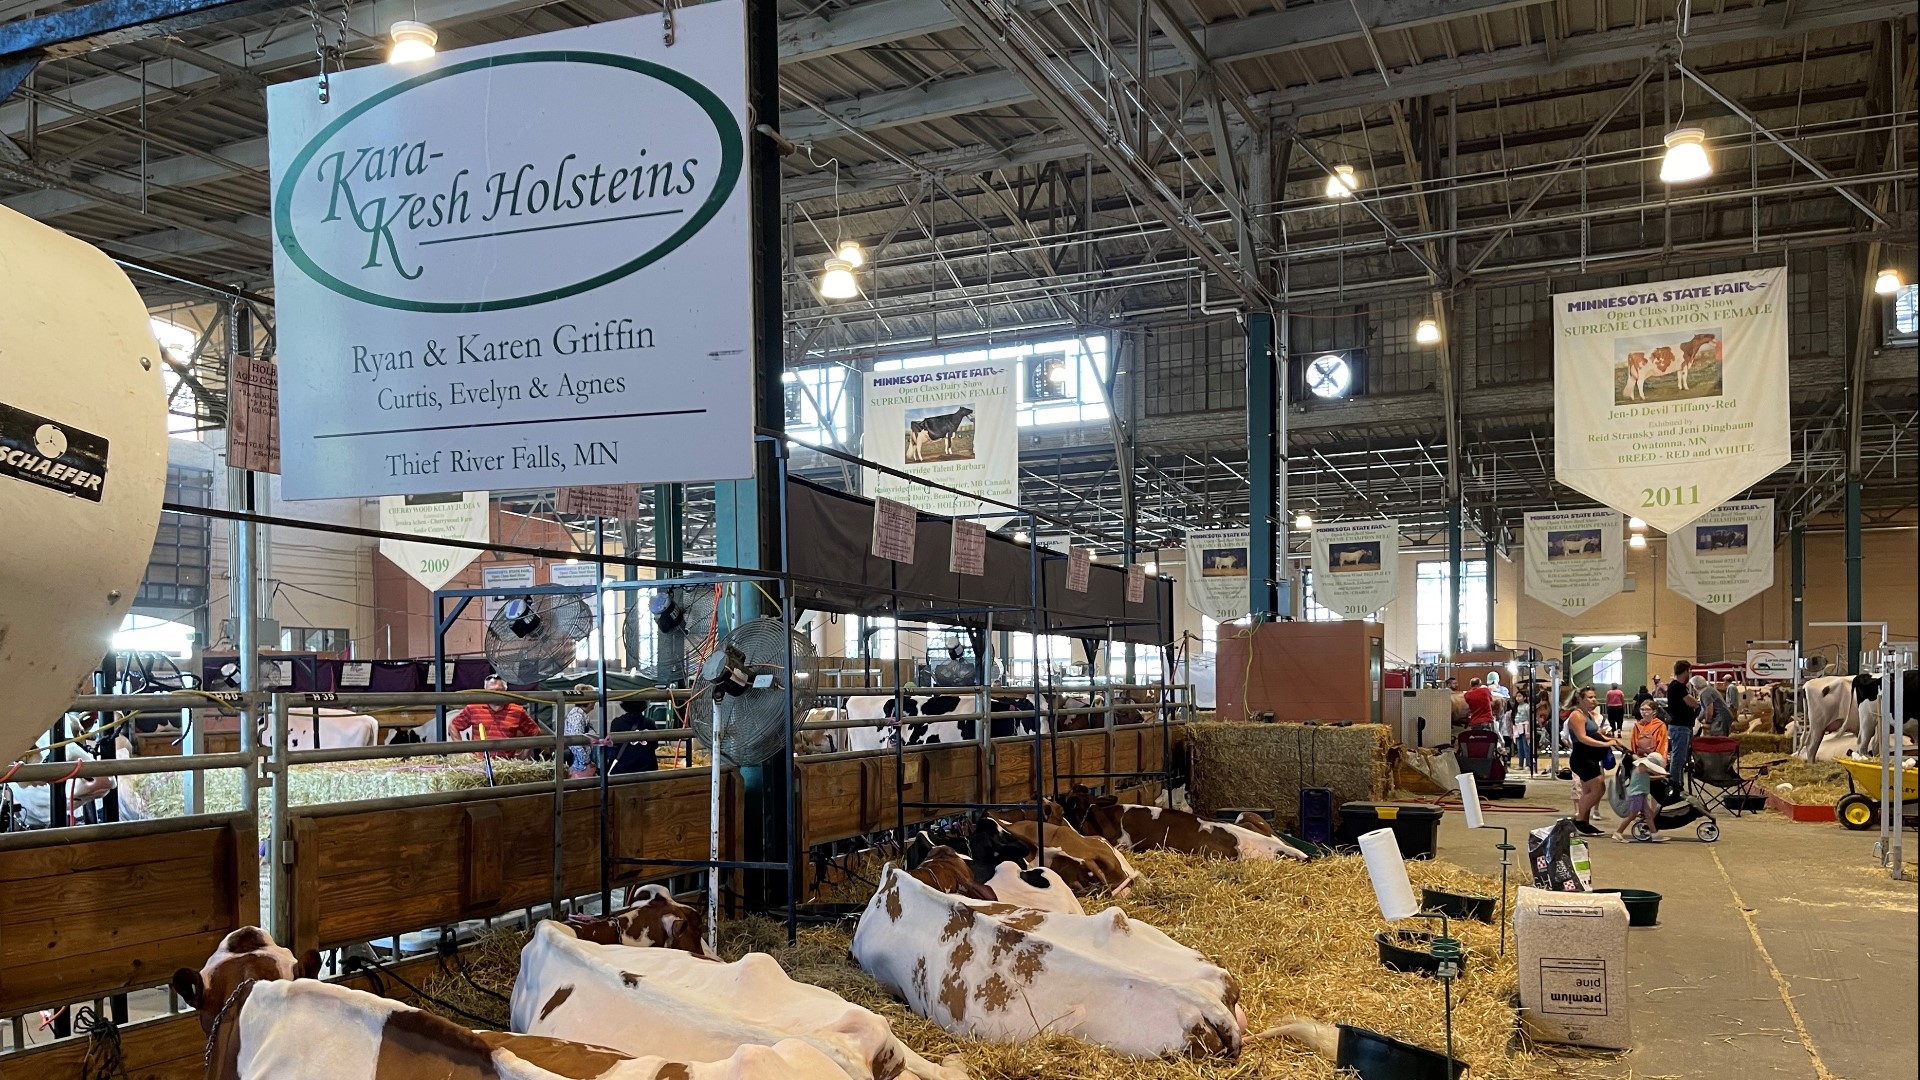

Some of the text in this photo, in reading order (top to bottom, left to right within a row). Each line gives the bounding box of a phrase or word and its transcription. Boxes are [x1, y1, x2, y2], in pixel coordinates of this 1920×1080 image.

[317, 139, 444, 233] Kara-
[360, 148, 699, 281] Kesh Holsteins
[1567, 281, 1757, 312] MINNESOTA STATE FAIR
[1607, 297, 1735, 321] Open Class Dairy Show
[1564, 303, 1773, 337] SUPREME CHAMPION FEMALE
[351, 318, 656, 381] Ryan & Karen Griffin
[873, 367, 1001, 386] MINNESOTA STATE FAIR
[378, 372, 627, 412] Curtis, Evelyn & Agnes
[870, 386, 1009, 406] SUPREME CHAMPION FEMALE
[899, 380, 983, 394] Open Class Dairy Show
[1607, 399, 1737, 420] Jen-D Devil Tiffany-Red
[1588, 421, 1754, 442] Reid Stransky and Jeni Dingbaum
[1683, 418, 1693, 427] by
[1618, 453, 1657, 463] BREED
[1666, 450, 1690, 459] RED
[1692, 448, 1711, 457] and
[1714, 443, 1756, 455] WHITE
[1632, 437, 1708, 451] Owatonna, MN
[0, 446, 102, 491] SCHAEFER
[385, 441, 620, 477] Thief River Falls, MN
[932, 465, 955, 473] Talent
[956, 463, 986, 471] Barbara
[984, 479, 1011, 487] Canada
[987, 488, 1013, 496] Canada
[1641, 484, 1701, 508] 2011
[420, 558, 450, 573] 2009
[1561, 597, 1586, 607] 2011
[1706, 593, 1733, 604] 2011
[1216, 609, 1237, 618] 2010
[1344, 604, 1368, 614] 2010
[1575, 977, 1601, 990] pine
[1550, 992, 1602, 1005] premium
